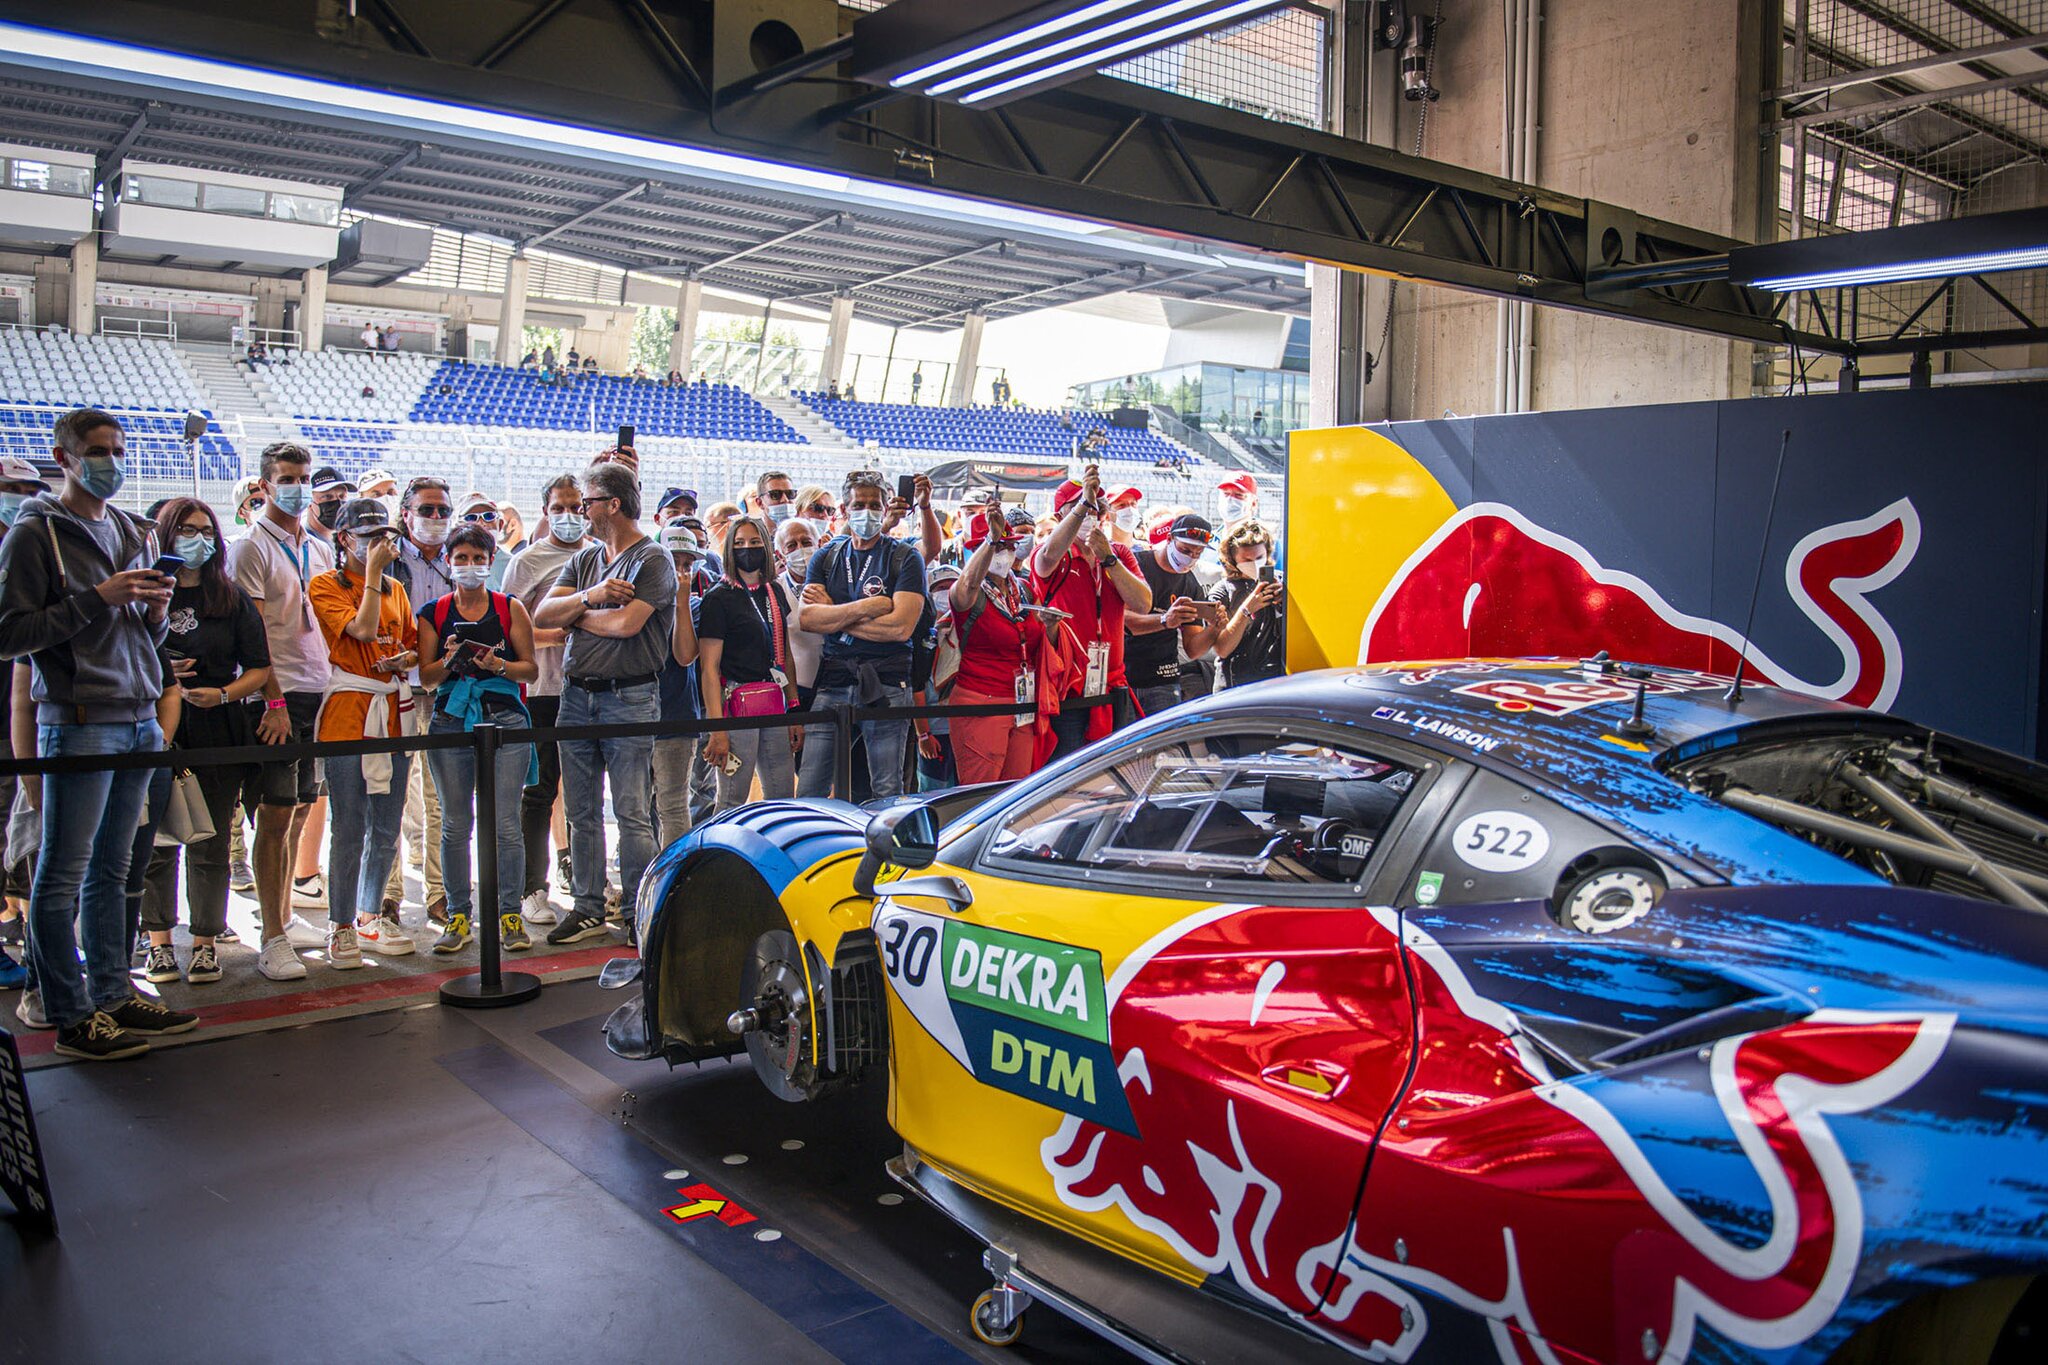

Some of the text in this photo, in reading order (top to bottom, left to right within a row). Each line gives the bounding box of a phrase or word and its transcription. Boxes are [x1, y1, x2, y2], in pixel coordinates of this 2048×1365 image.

[974, 464, 1005, 474] HAUPT
[859, 554, 873, 582] DTM.COM
[1392, 709, 1499, 753] L. LAWSON
[1466, 822, 1534, 859] 522
[884, 918, 938, 988] 30
[949, 936, 1089, 1022] DEKRA
[990, 1028, 1097, 1105] DTM
[0, 1046, 46, 1211] CLUTCH &
